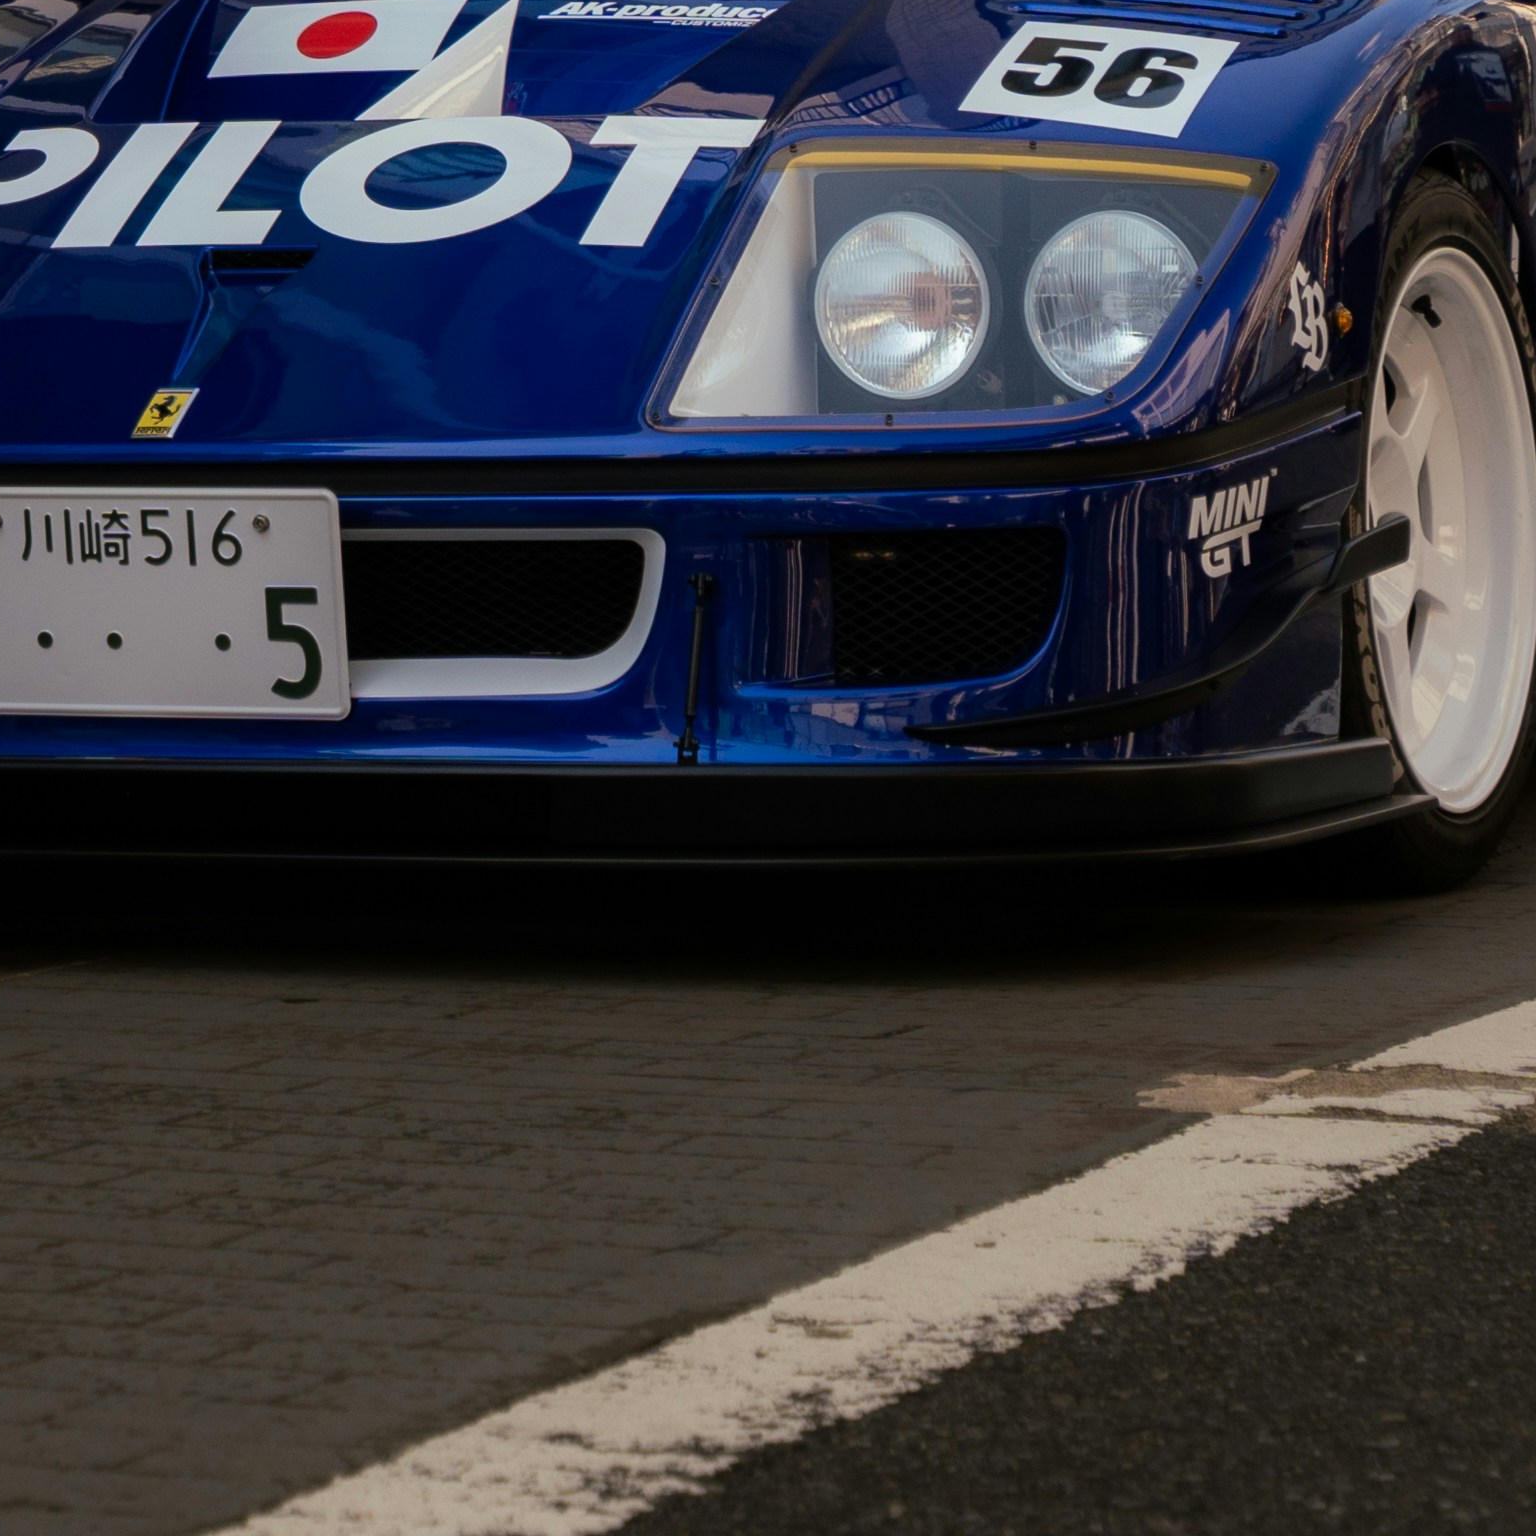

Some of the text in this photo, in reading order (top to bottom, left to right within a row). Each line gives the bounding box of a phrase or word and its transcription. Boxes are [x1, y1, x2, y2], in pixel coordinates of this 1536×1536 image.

[1000, 37, 1199, 109] 56
[1187, 474, 1270, 540] MINI
[1200, 519, 1262, 579] GT
